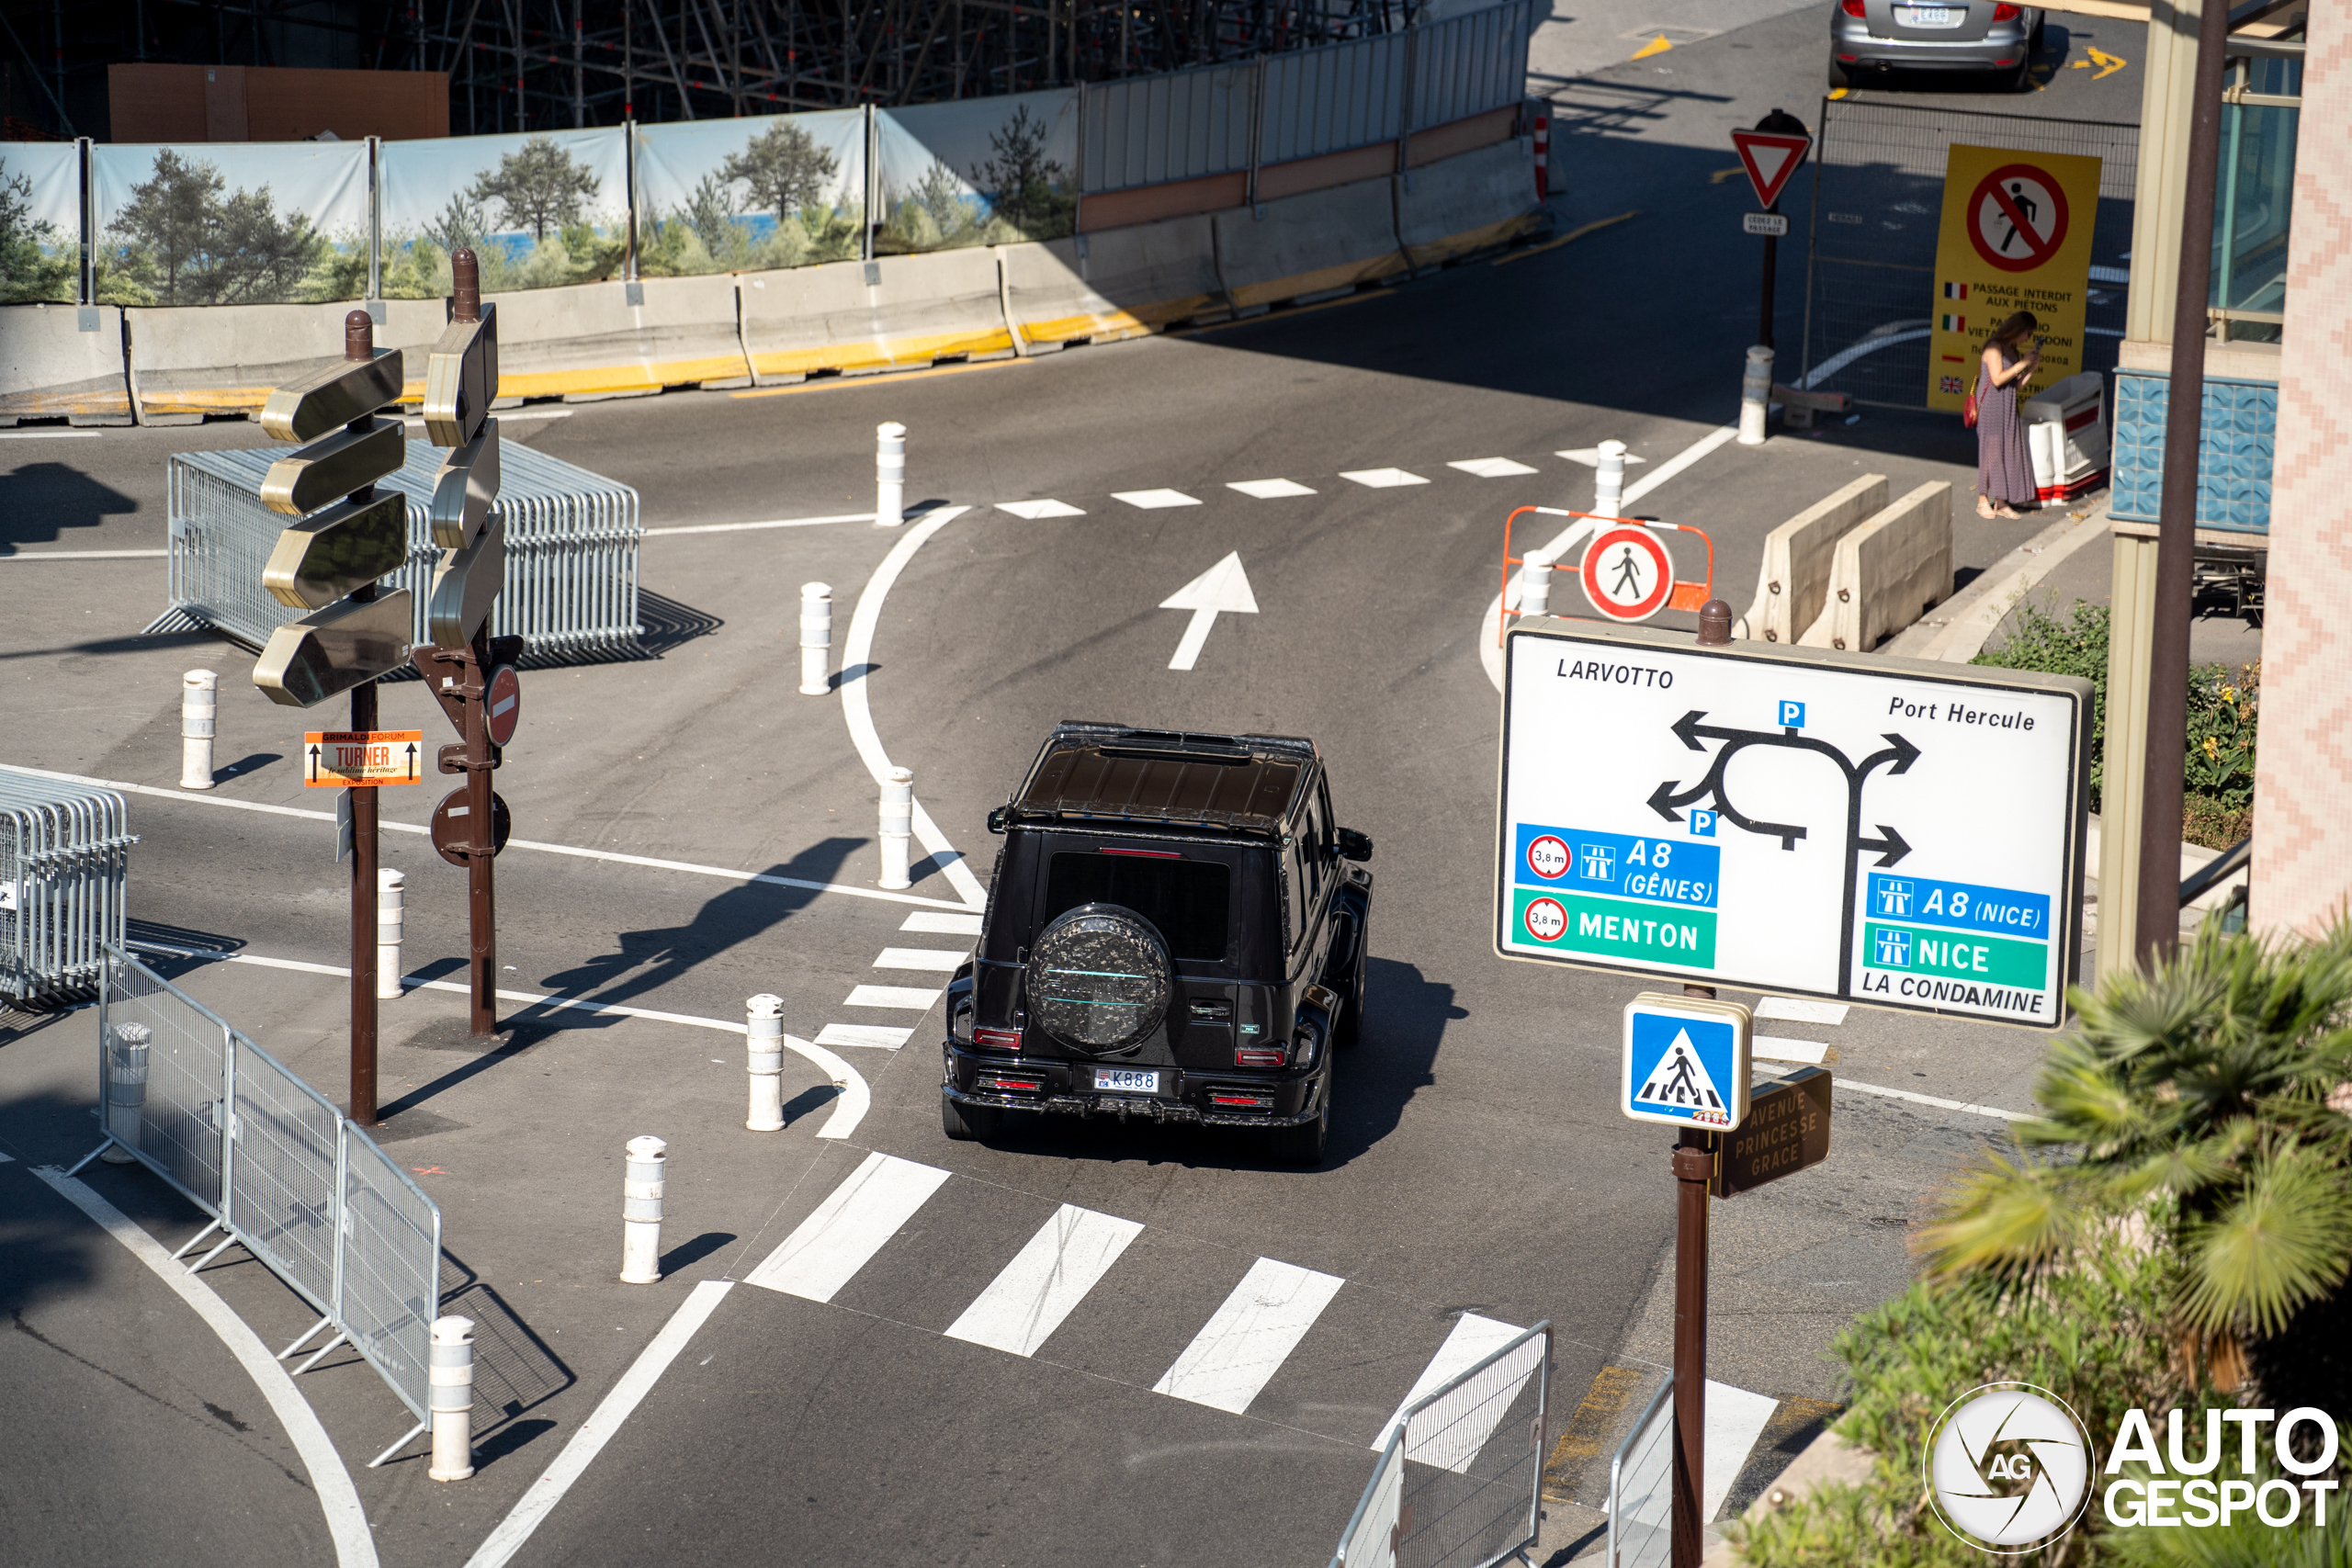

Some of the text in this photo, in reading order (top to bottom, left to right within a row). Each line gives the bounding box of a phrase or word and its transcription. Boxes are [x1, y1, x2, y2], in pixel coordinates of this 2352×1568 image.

[1748, 224, 1781, 234] PASSAGE
[1973, 282, 2073, 302] PASSAGE INTERDIT
[1985, 296, 2058, 313] AUX PIÉTONS
[1556, 659, 1674, 689] LARVOTTO
[1783, 702, 1801, 725] P
[1888, 696, 2035, 731] Port Hercule
[322, 732, 405, 741] GRIMALDI FORUM
[335, 746, 390, 767] TURNER
[336, 766, 367, 774] sublime
[368, 766, 398, 775] héritage
[1694, 812, 1712, 834] P
[1534, 850, 1566, 863] 3,8 m
[1625, 839, 1672, 868] A8
[1623, 872, 1713, 904] (GÊNES)
[1532, 912, 1562, 926] 3,8 m
[1921, 888, 2041, 930] A8 (NICE)
[1578, 911, 1698, 952] MENTON
[1918, 938, 1990, 973] NICE
[1862, 972, 2044, 1014] LA CONDAMINE
[1113, 1071, 1154, 1089] K888
[1749, 1090, 1806, 1129] AVENUE
[1736, 1111, 1817, 1159] PRINCESSE
[1751, 1143, 1799, 1177] GRACE
